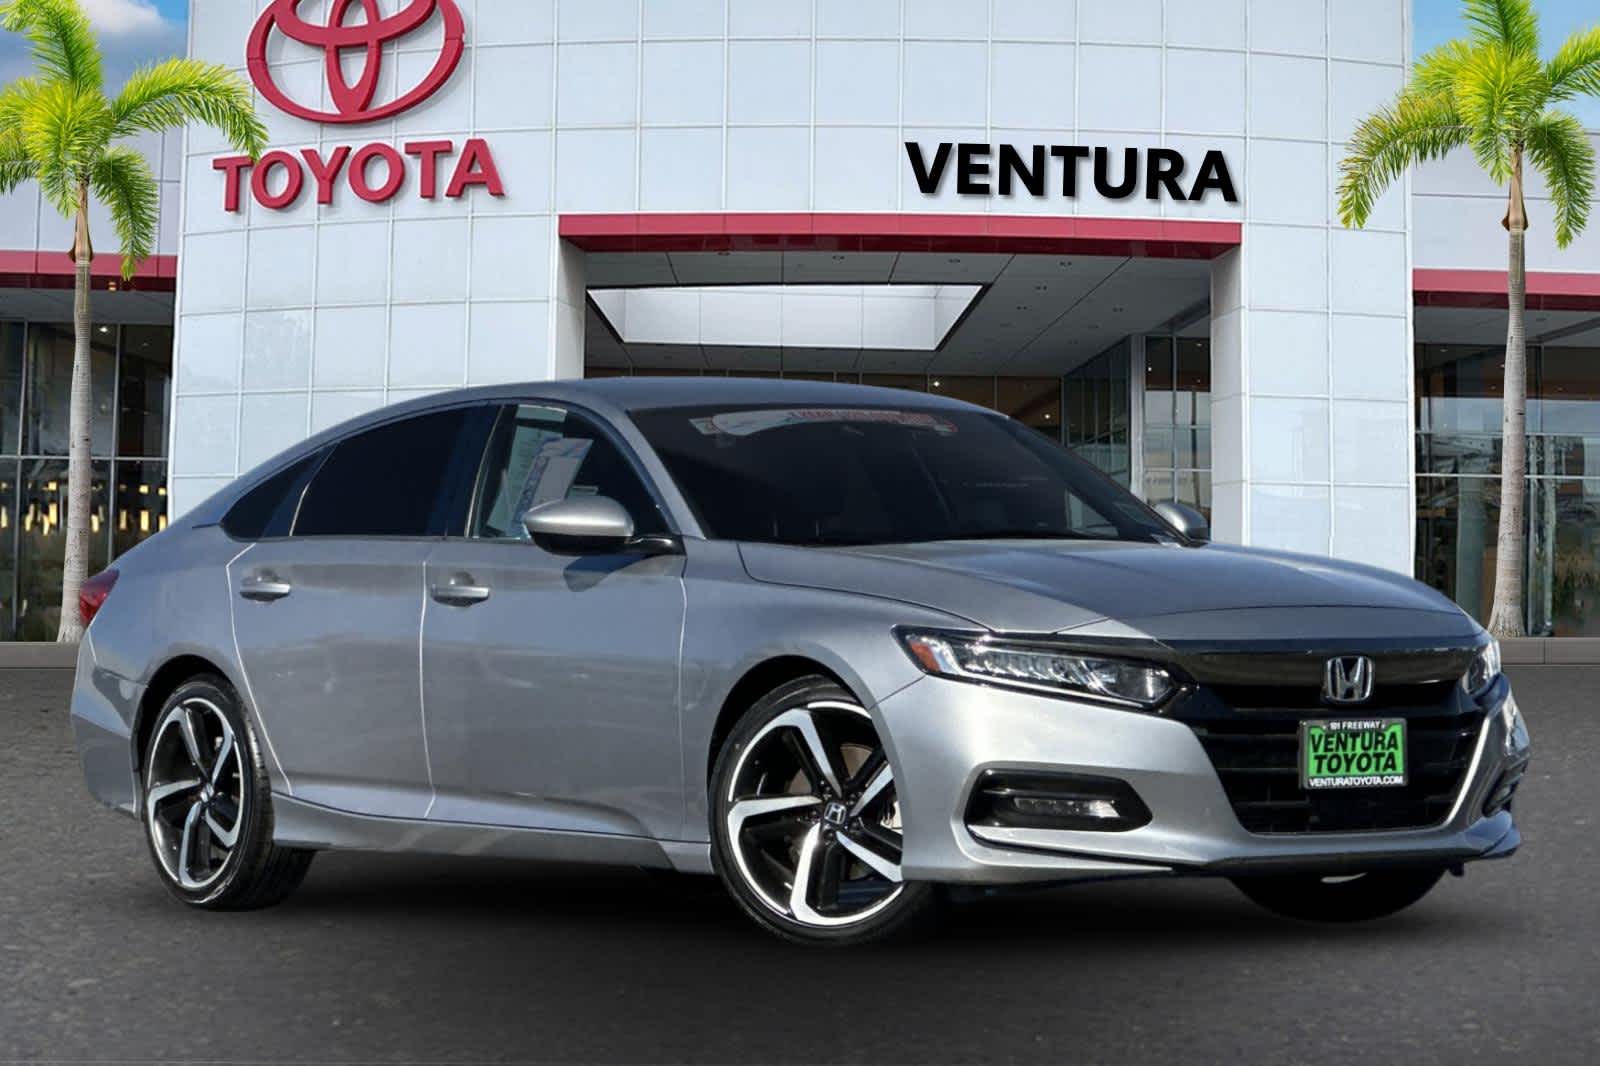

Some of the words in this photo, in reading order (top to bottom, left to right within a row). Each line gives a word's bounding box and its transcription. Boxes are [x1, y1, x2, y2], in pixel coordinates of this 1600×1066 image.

[212, 138, 505, 212] TOYOTA
[904, 142, 1238, 202] VENTURA
[1342, 720, 1381, 729] FREEWAY
[1311, 731, 1399, 753] VENTURA
[1314, 752, 1397, 773] TOYOTA
[1309, 776, 1403, 787] VENTURATOYOTA.COM
